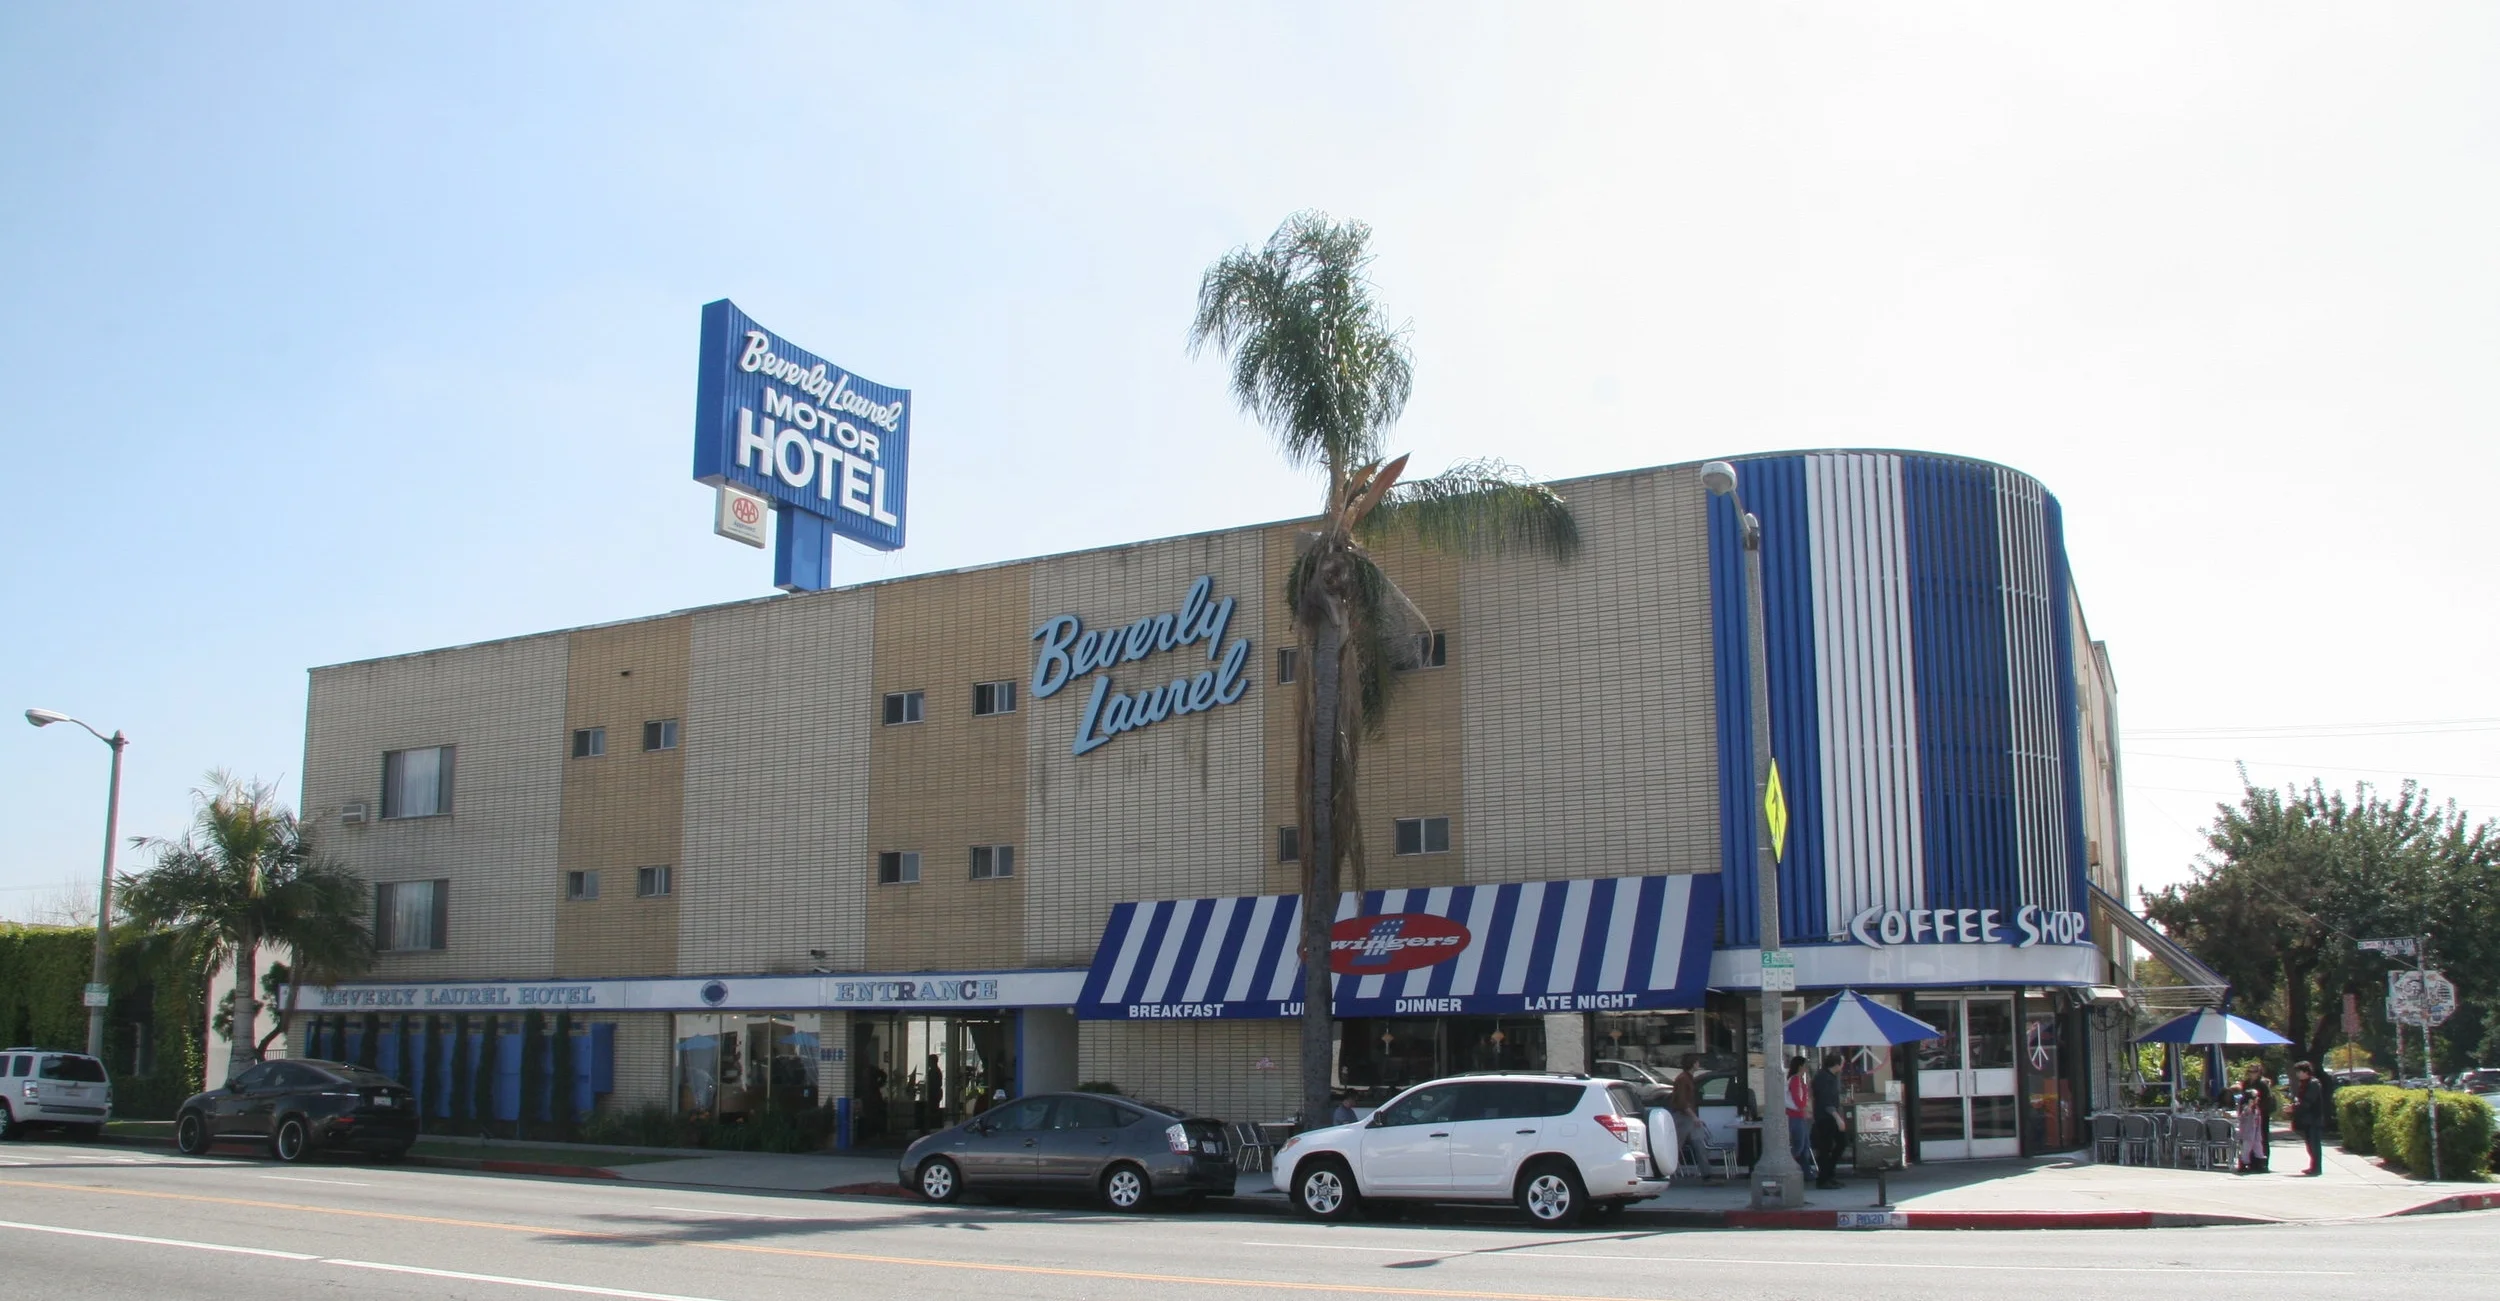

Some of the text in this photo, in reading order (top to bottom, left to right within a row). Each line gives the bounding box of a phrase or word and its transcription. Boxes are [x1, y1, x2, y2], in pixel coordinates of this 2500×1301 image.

[739, 330, 902, 433] Beverly Laurel
[763, 386, 880, 461] MOTOR
[736, 406, 897, 527] HOTEL
[735, 499, 757, 522] AAA
[1032, 574, 1236, 700] Beverly
[1071, 638, 1250, 756] Laurel
[1850, 904, 2086, 950] COFFEE SHOP
[1304, 935, 1462, 954] wingers
[1763, 952, 1771, 964] 2
[321, 986, 597, 1006] BEVERLY LAUREL HOTEL
[835, 979, 998, 1001] ENTRANCE
[1128, 1003, 1224, 1018] BREAKFAST
[1395, 998, 1462, 1013] DINNER
[1524, 994, 1637, 1011] LATE NIGHT
